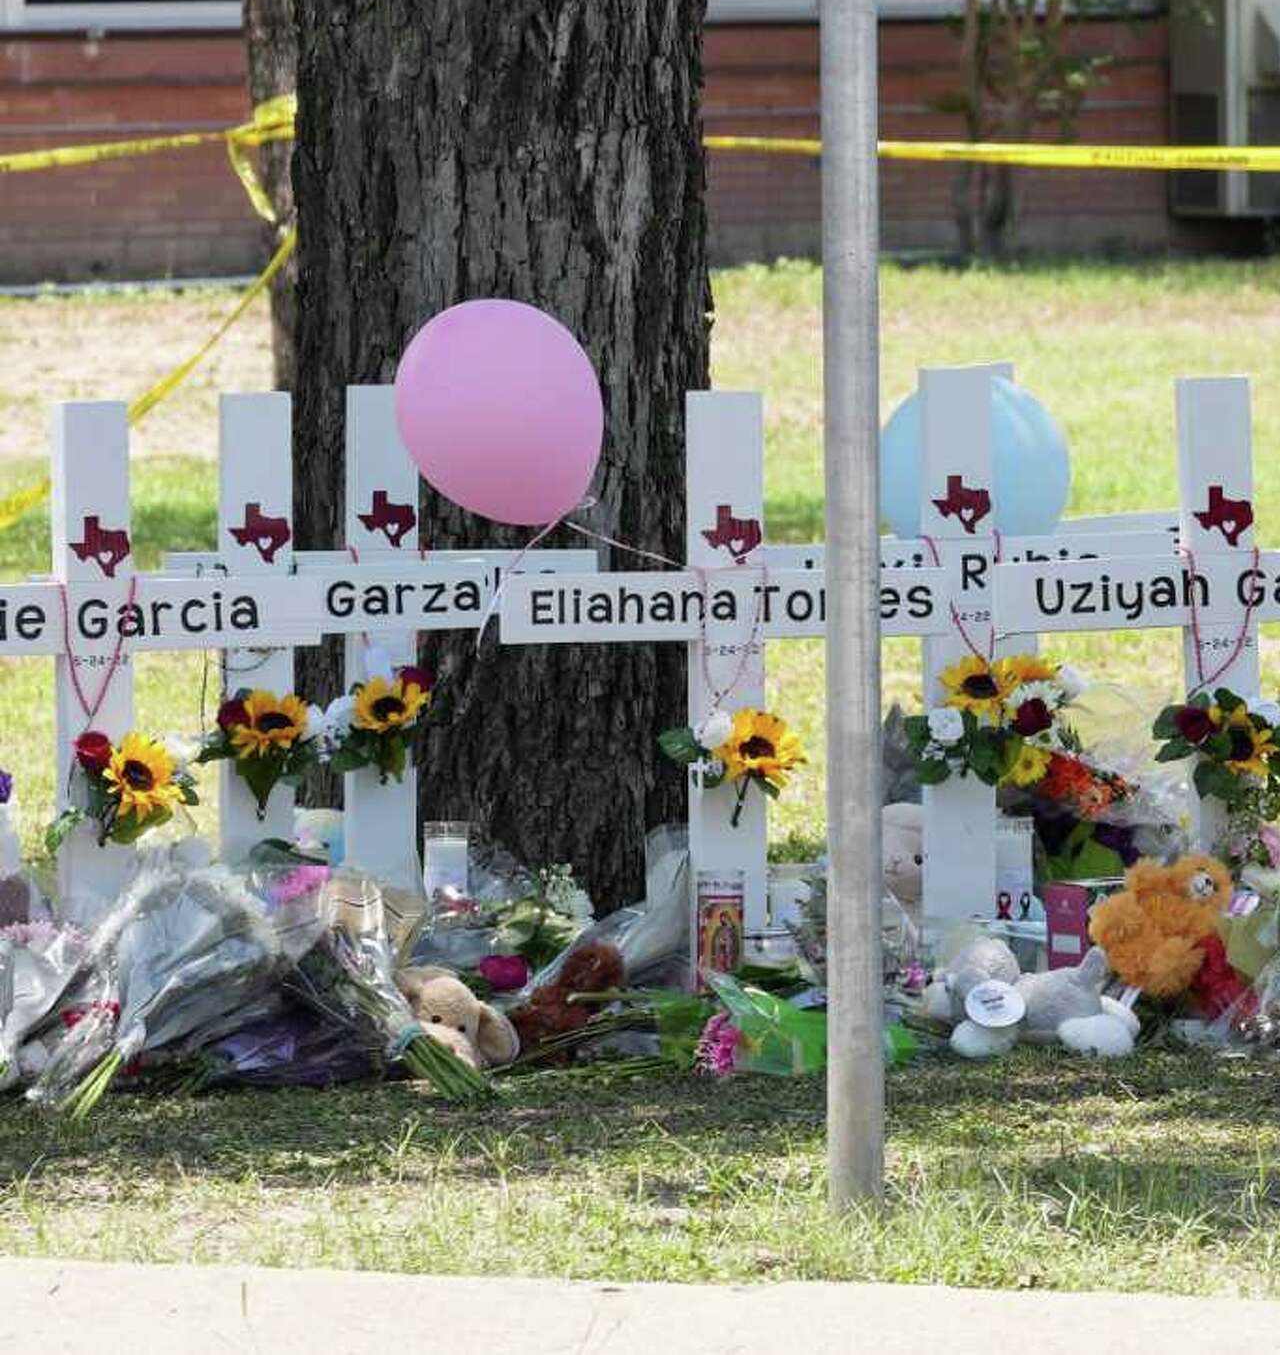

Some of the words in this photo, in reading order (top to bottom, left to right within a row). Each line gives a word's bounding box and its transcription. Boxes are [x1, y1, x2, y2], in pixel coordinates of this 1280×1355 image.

[77, 591, 259, 640] Garcia
[326, 580, 481, 618] Garza
[531, 586, 738, 625] Eliahana
[755, 584, 934, 623] Toes
[1035, 569, 1210, 619] Uziyah
